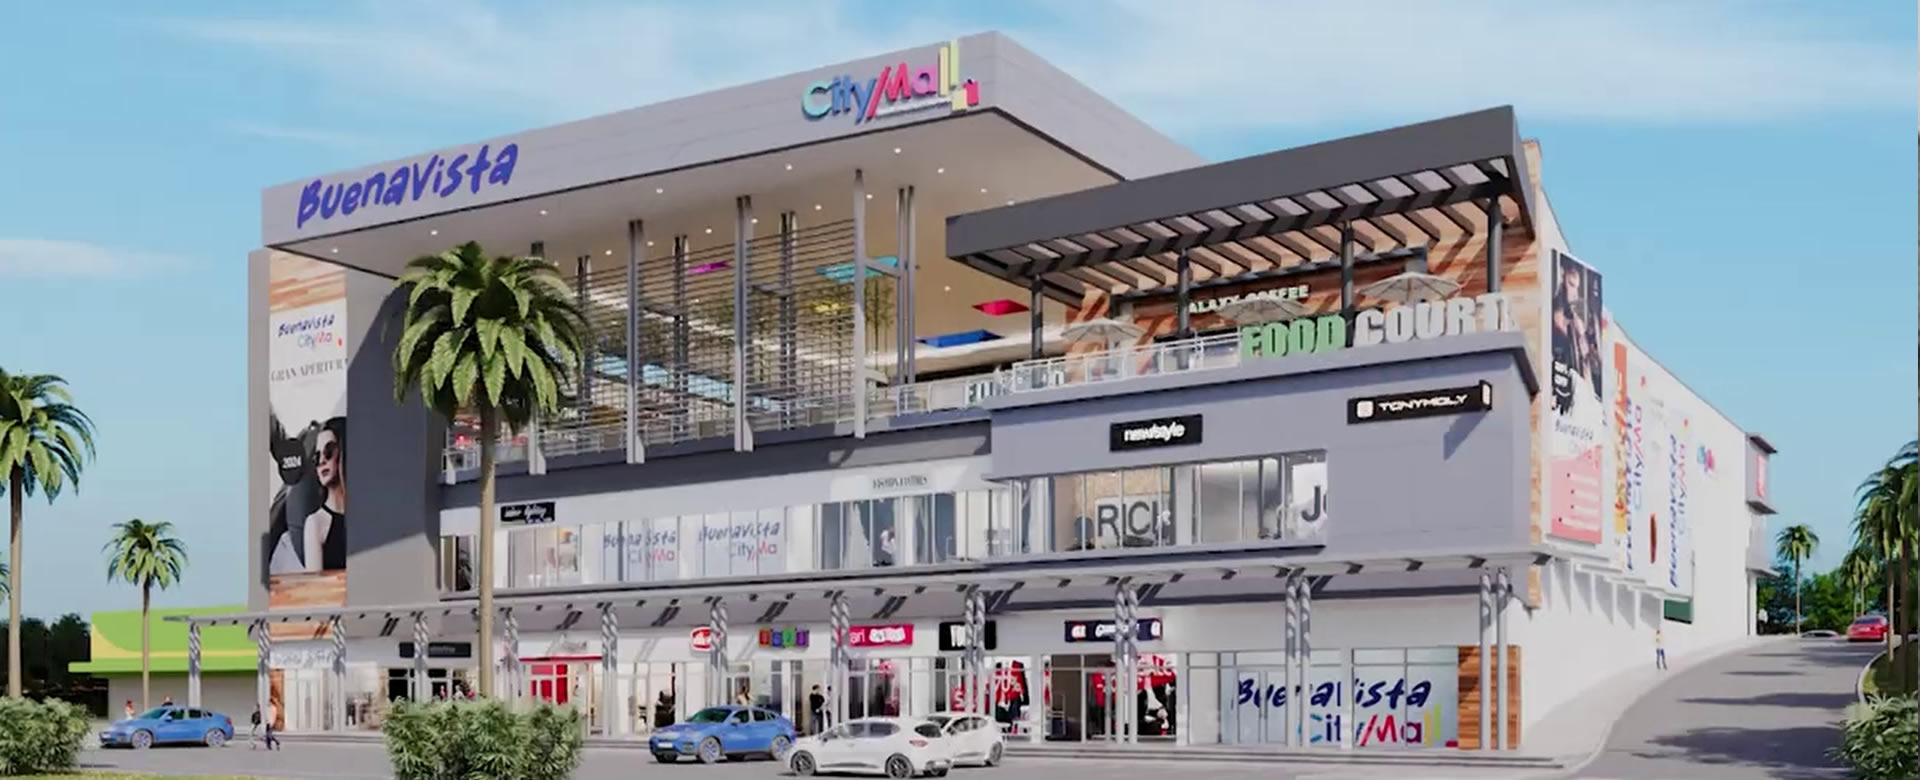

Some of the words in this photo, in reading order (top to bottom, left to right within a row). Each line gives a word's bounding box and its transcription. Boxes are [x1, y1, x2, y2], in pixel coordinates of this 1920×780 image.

[1188, 294, 1241, 314] ALAXY
[1242, 312, 1347, 361] FOOD
[1353, 292, 1515, 347] COURT
[1378, 394, 1468, 412] TONYMOLY
[1297, 703, 1442, 747] CitMall
